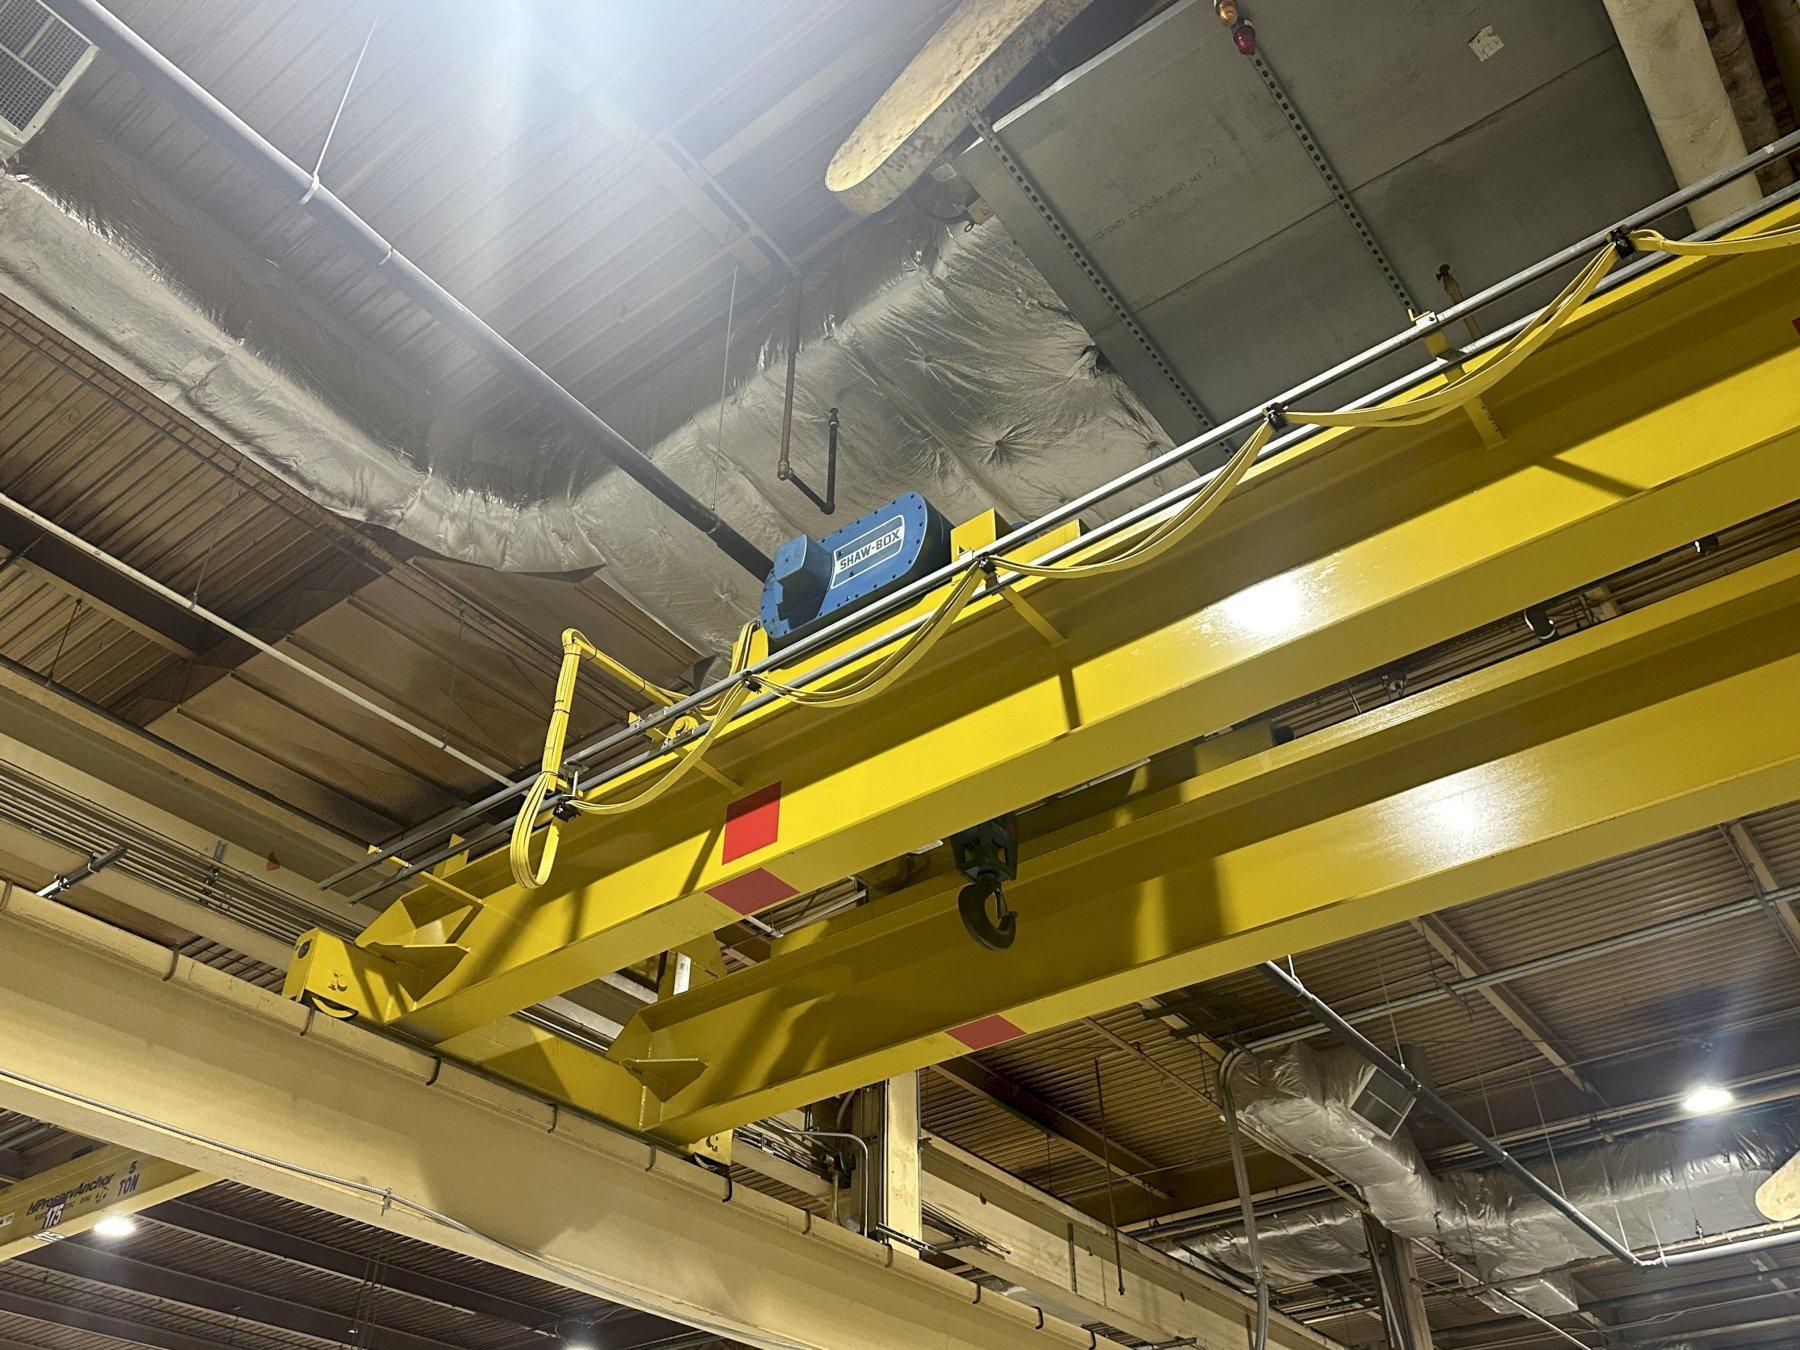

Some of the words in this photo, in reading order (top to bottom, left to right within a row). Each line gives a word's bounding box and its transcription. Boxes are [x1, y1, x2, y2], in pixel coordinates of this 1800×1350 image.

[840, 529, 900, 570] SHAW-BOX
[129, 1161, 137, 1174] 5
[117, 1173, 140, 1196] TON
[43, 1203, 65, 1229] 175
